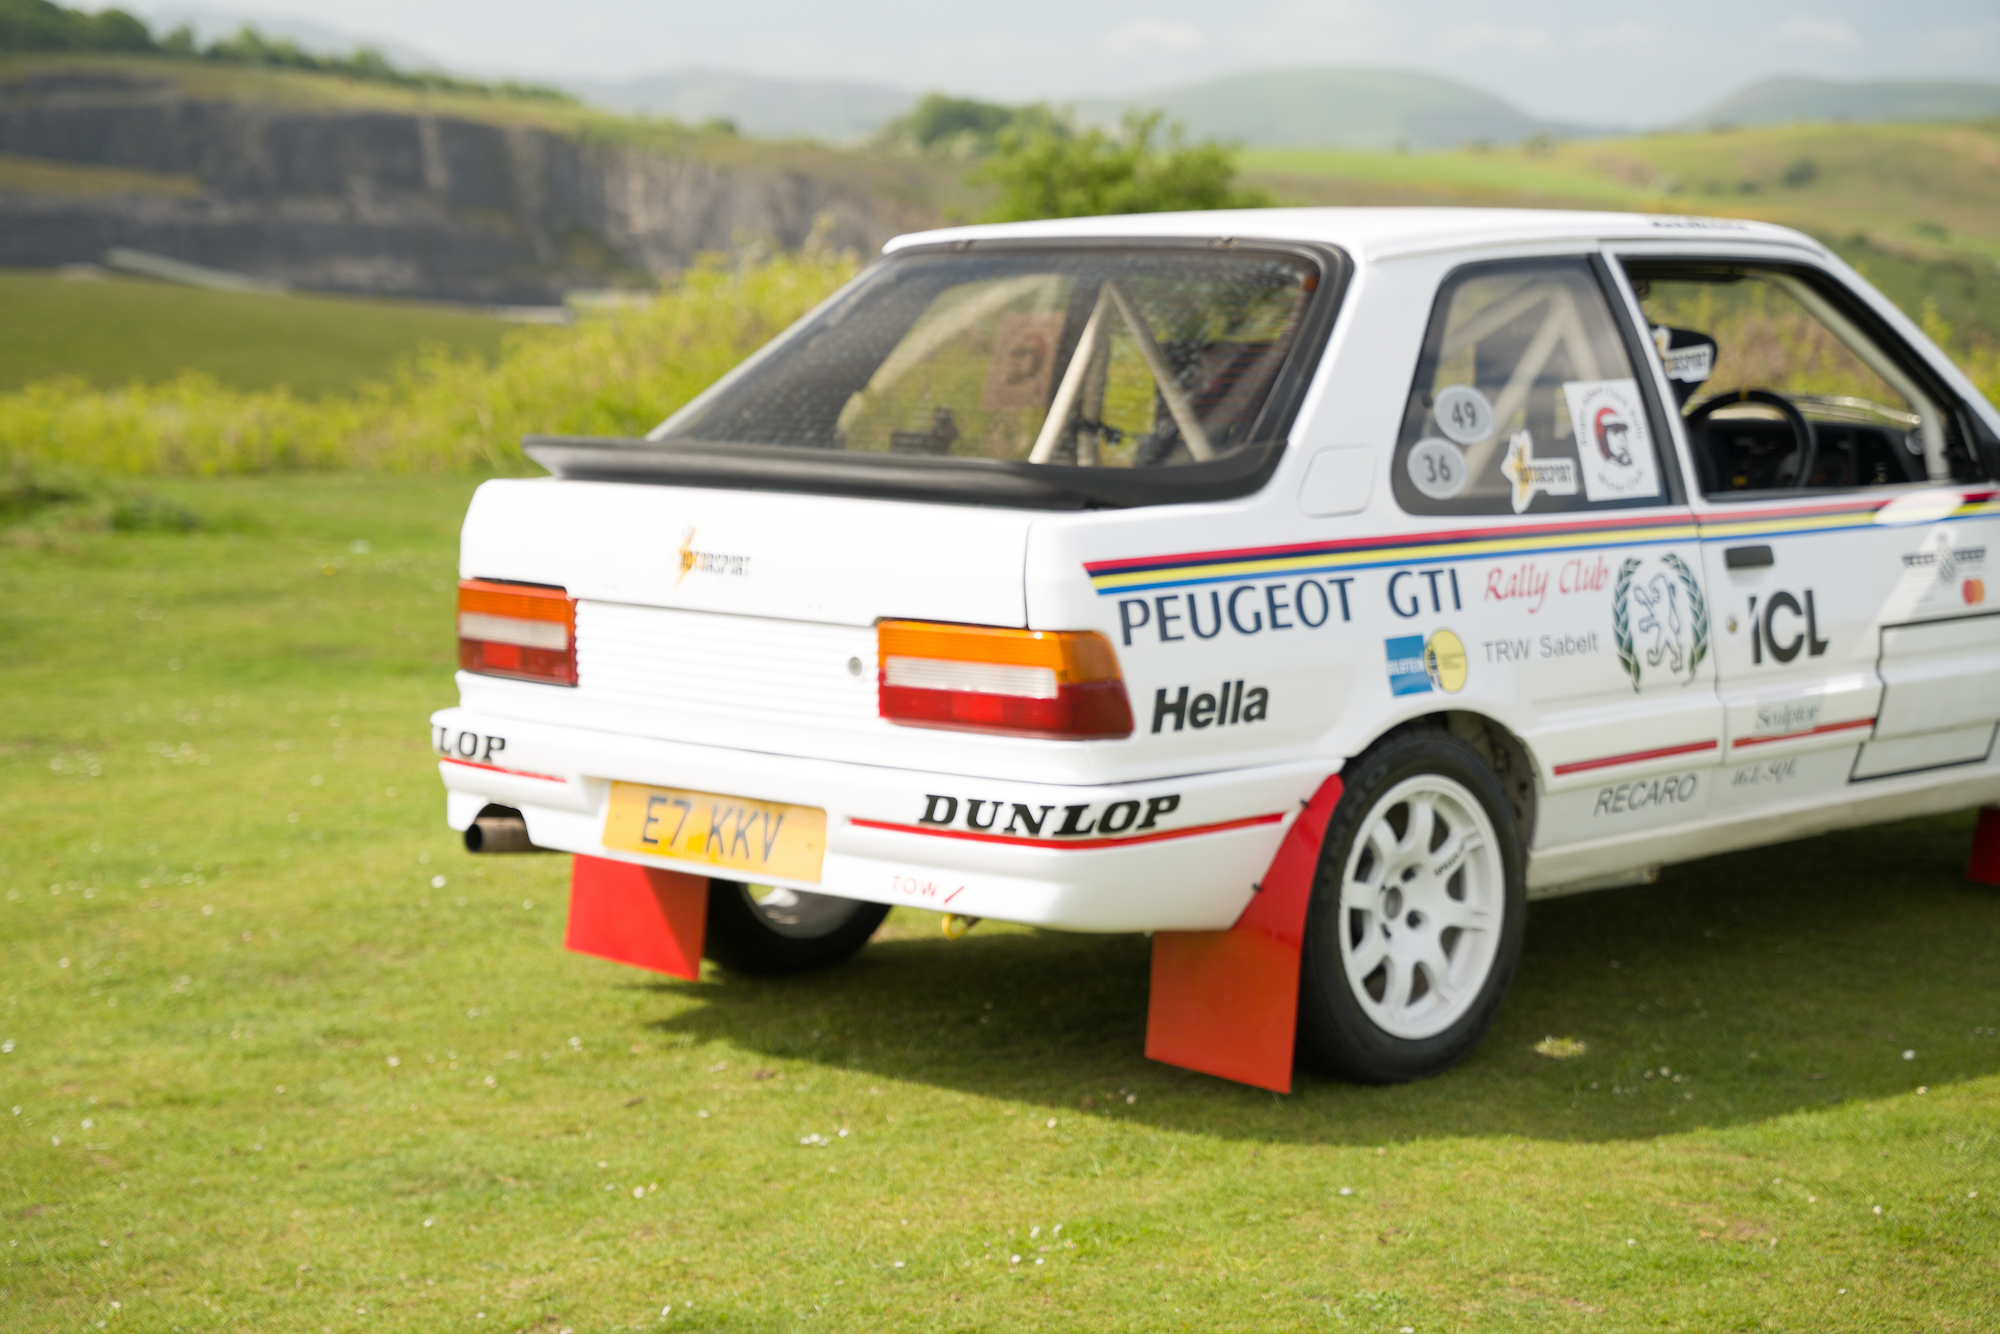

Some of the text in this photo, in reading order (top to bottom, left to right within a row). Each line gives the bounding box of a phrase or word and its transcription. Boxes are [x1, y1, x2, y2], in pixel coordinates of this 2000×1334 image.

[1451, 401, 1477, 430] 49
[1422, 455, 1452, 484] 36
[1484, 554, 1609, 615] Rally Club
[1118, 568, 1462, 646] PEUGEOT GTI
[1748, 589, 1829, 666] ICL
[1386, 655, 1425, 676] BILSTEIN
[1482, 639, 1531, 665] TRW
[1540, 632, 1600, 659] Sabelt
[1150, 679, 1270, 734] Hella
[1756, 703, 1819, 732] Sculptor
[919, 794, 1182, 837] DUNLOP
[1593, 771, 1698, 817] RECARO
[641, 795, 786, 864] E7 KKV
[891, 875, 937, 899] TOW
